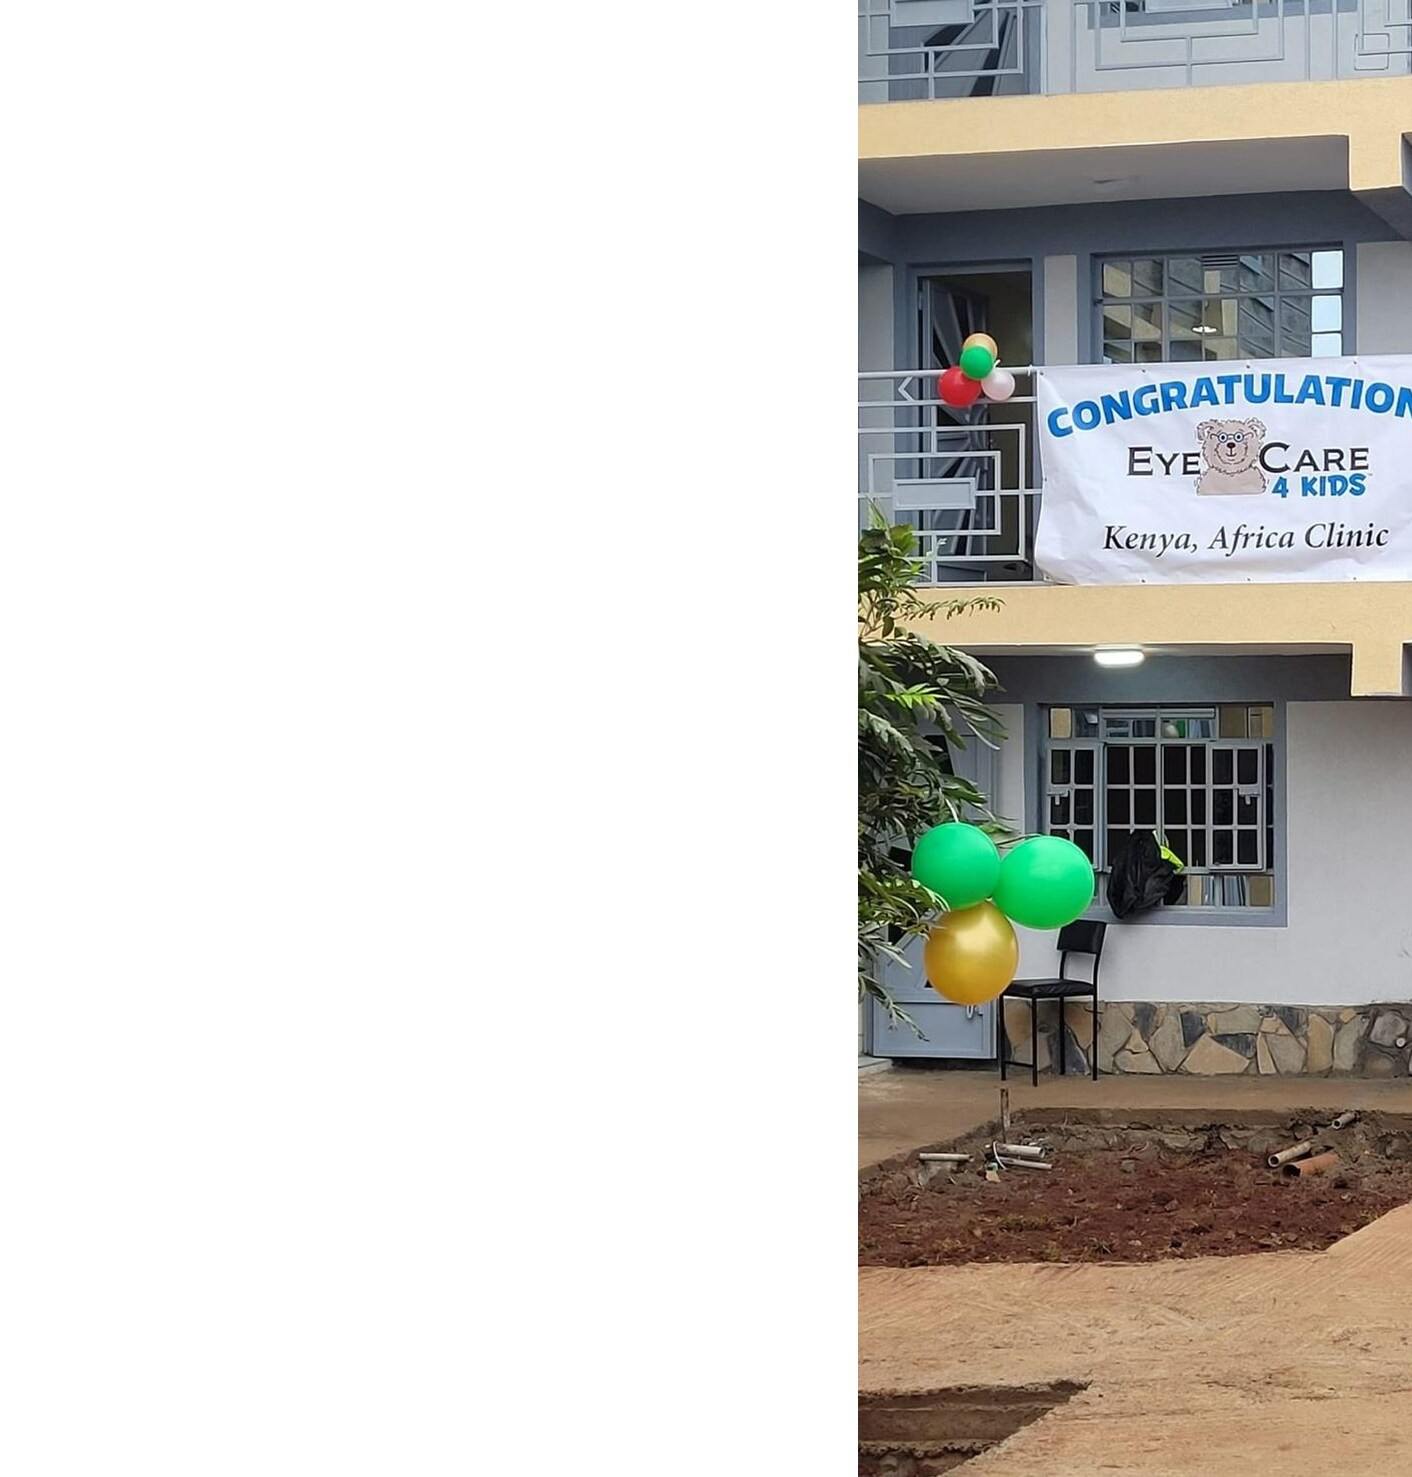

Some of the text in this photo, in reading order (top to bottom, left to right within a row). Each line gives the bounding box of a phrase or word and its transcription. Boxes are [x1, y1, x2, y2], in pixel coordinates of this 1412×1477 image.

[1127, 441, 1369, 476] EYE CARE
[1272, 473, 1367, 498] 4 KIDS
[1103, 522, 1390, 557] Kenya, Africa Clinic
